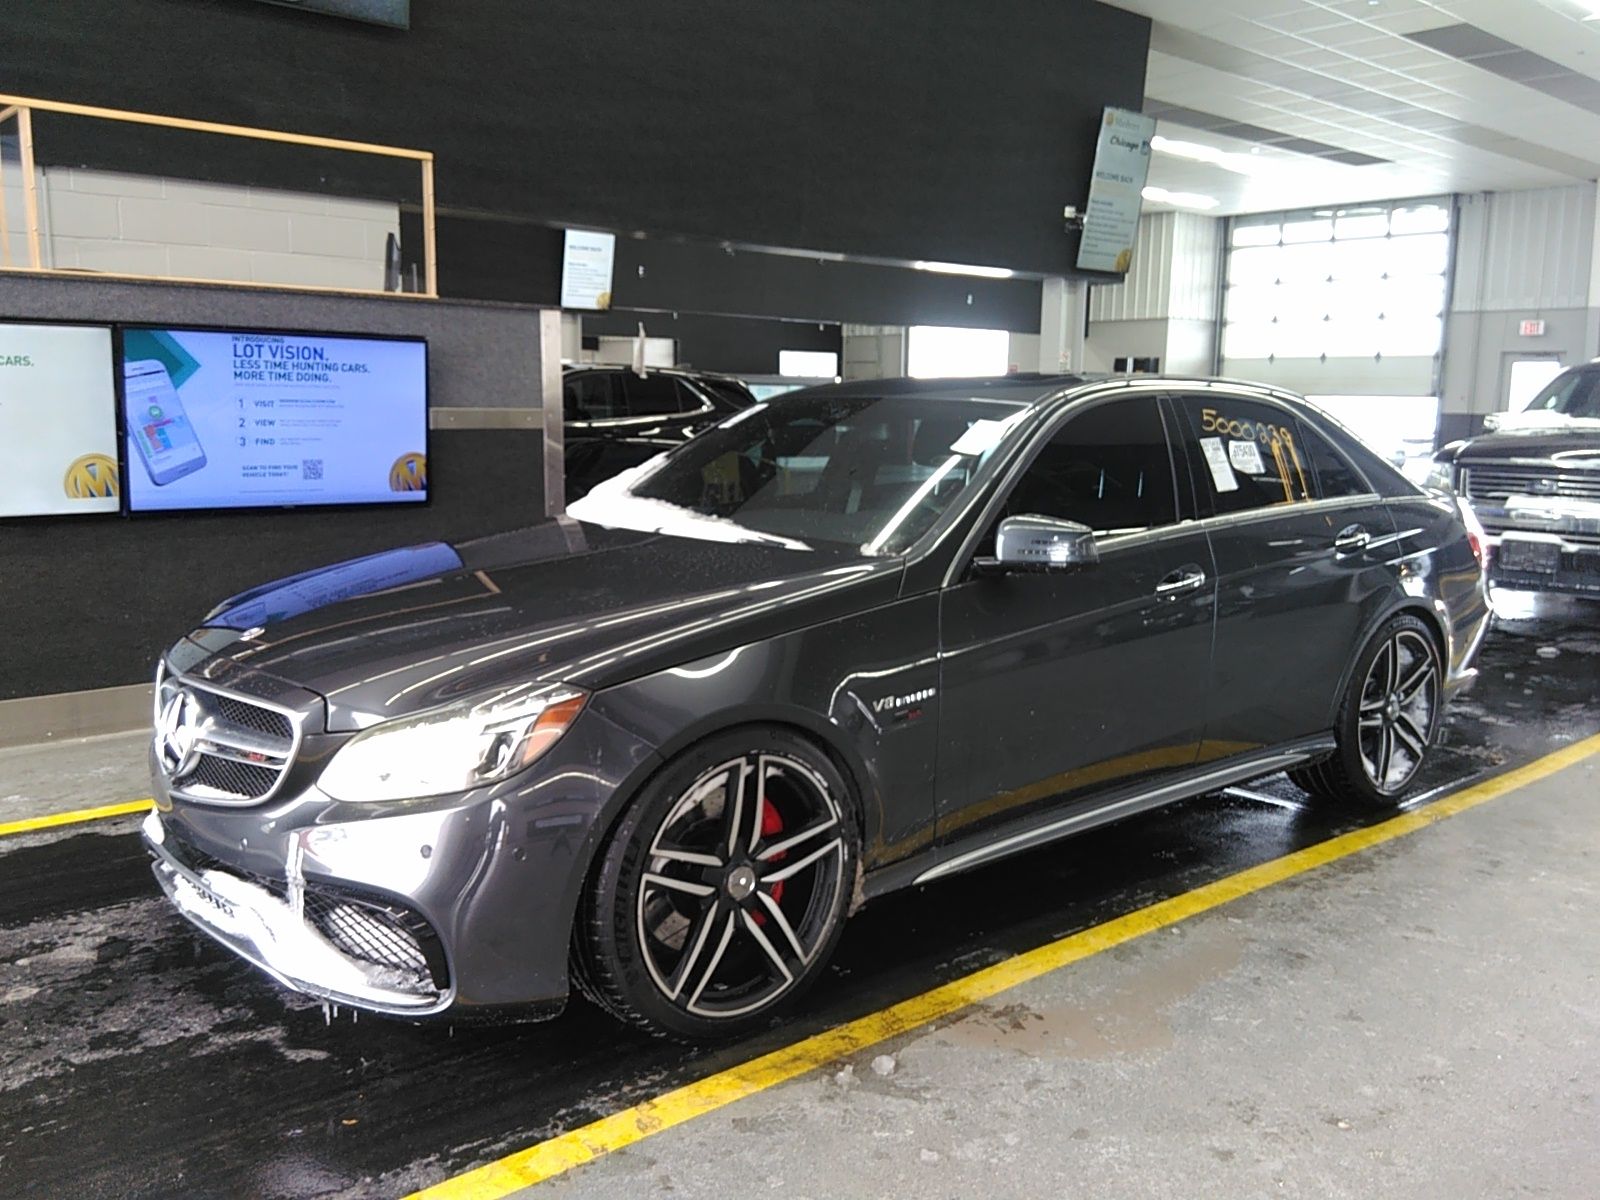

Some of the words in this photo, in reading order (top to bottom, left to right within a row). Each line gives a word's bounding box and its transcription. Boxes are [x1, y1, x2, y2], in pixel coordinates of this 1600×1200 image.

[233, 343, 264, 359] LOT
[268, 345, 329, 361] VISION.
[0, 355, 34, 368] CARS.
[233, 360, 261, 370] LESS
[263, 361, 290, 371] TIME
[291, 361, 339, 372] HUNTING
[341, 363, 371, 374] CARS.
[233, 371, 265, 381] MORE
[268, 371, 294, 382] TIME
[296, 372, 332, 383] DOING.
[254, 400, 275, 408] VISIT
[238, 418, 245, 428] 2
[254, 419, 276, 427] VIEW
[239, 437, 246, 447] 3
[255, 438, 275, 446] FIND
